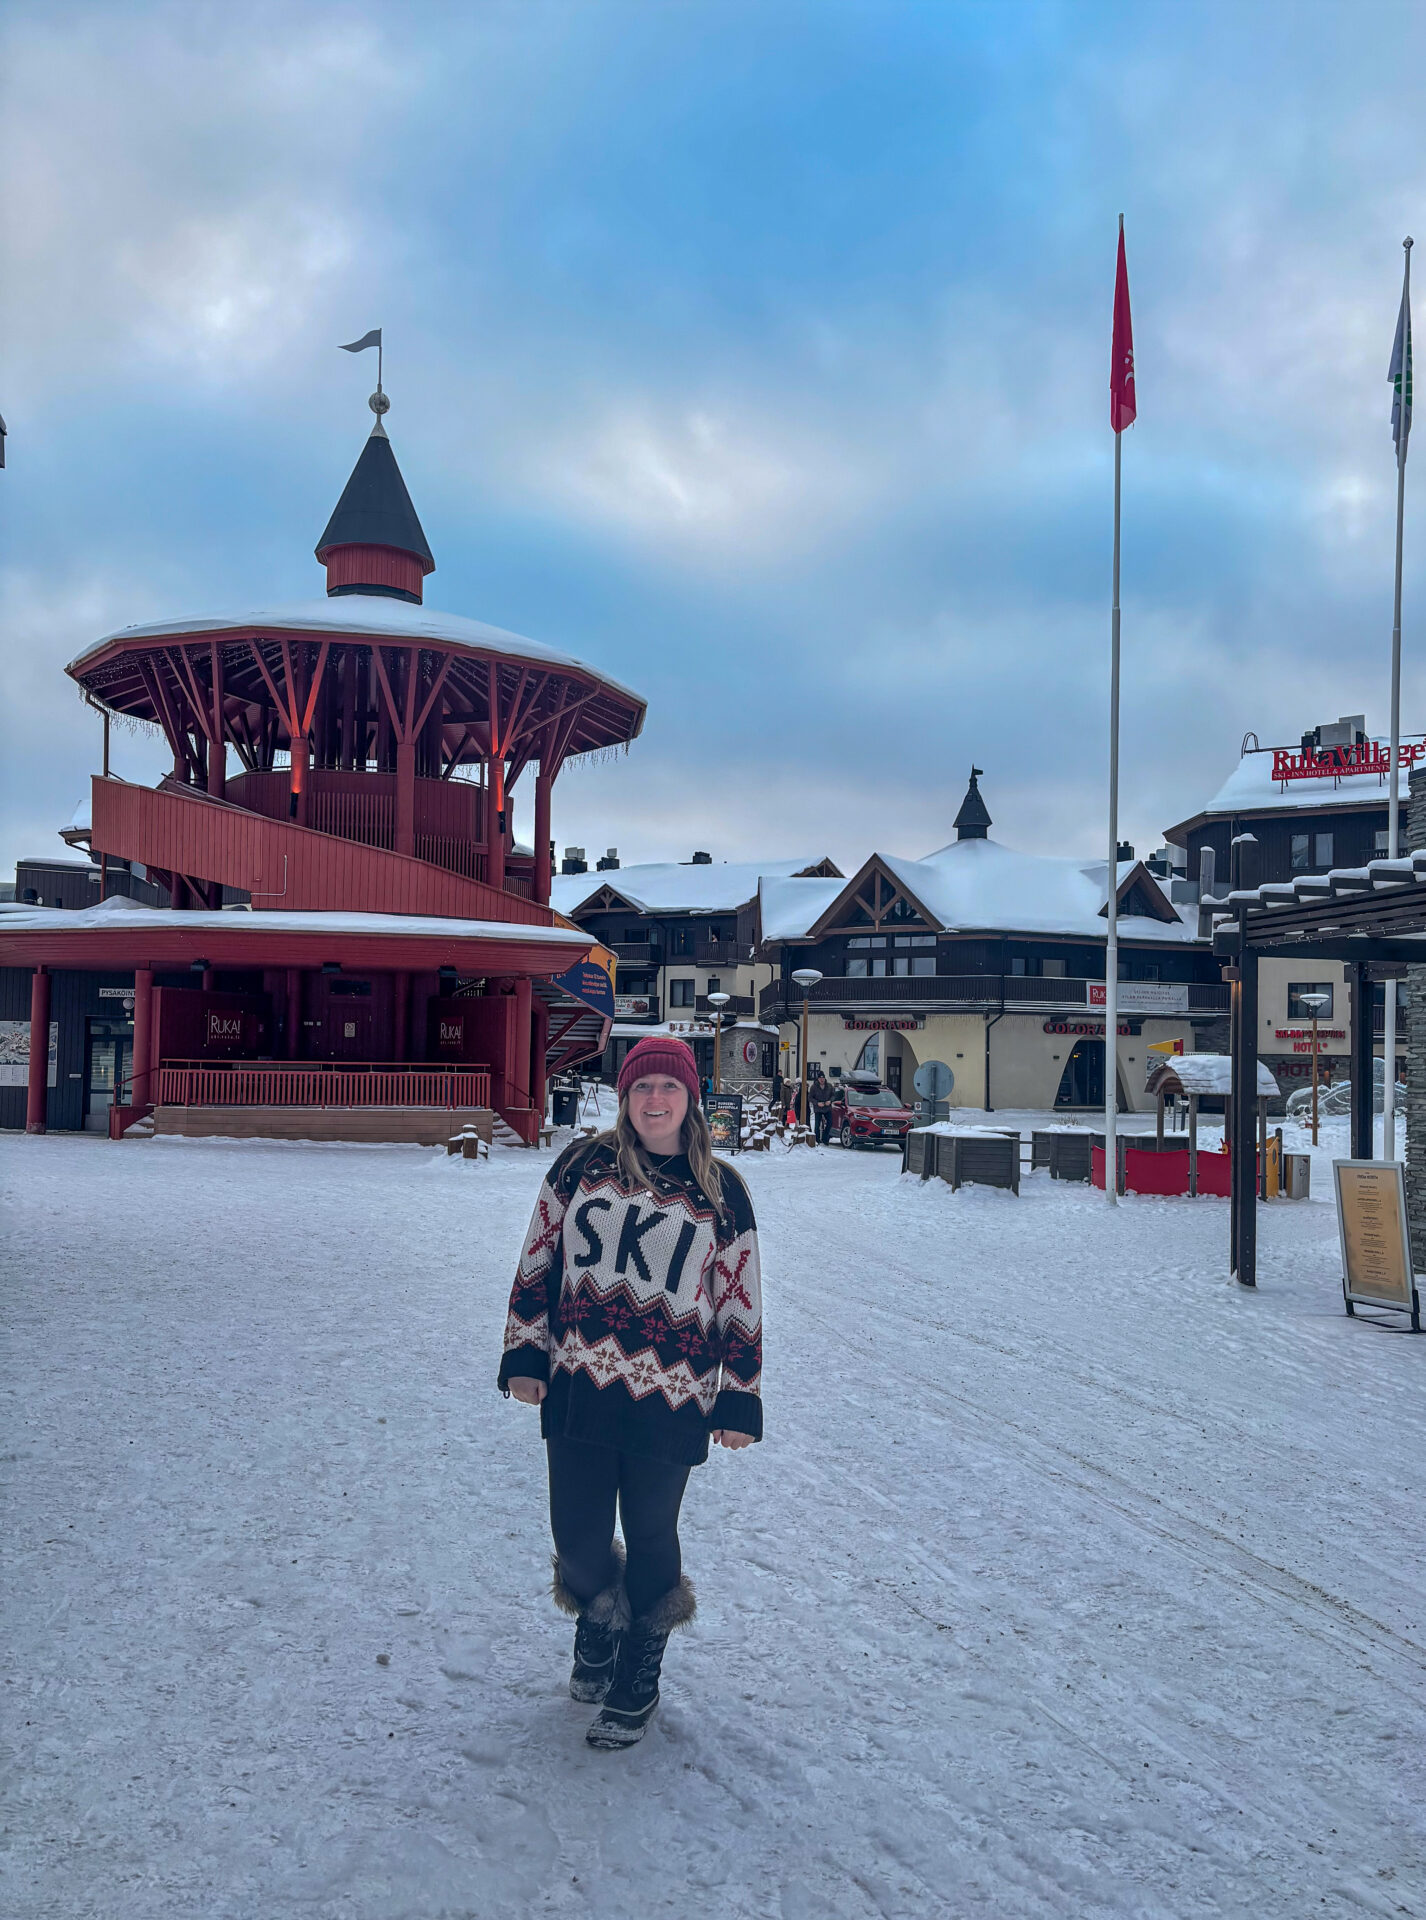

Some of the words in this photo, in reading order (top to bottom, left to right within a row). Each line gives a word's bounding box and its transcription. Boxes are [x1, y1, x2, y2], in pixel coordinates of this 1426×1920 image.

[1306, 769, 1332, 777] HOTEL
[1339, 765, 1390, 775] APARTMENTS
[845, 1020, 917, 1030] COLORADO
[1044, 1023, 1131, 1036] COLORAO
[1293, 1042, 1323, 1053] HOTL
[573, 1197, 697, 1294] SKI
